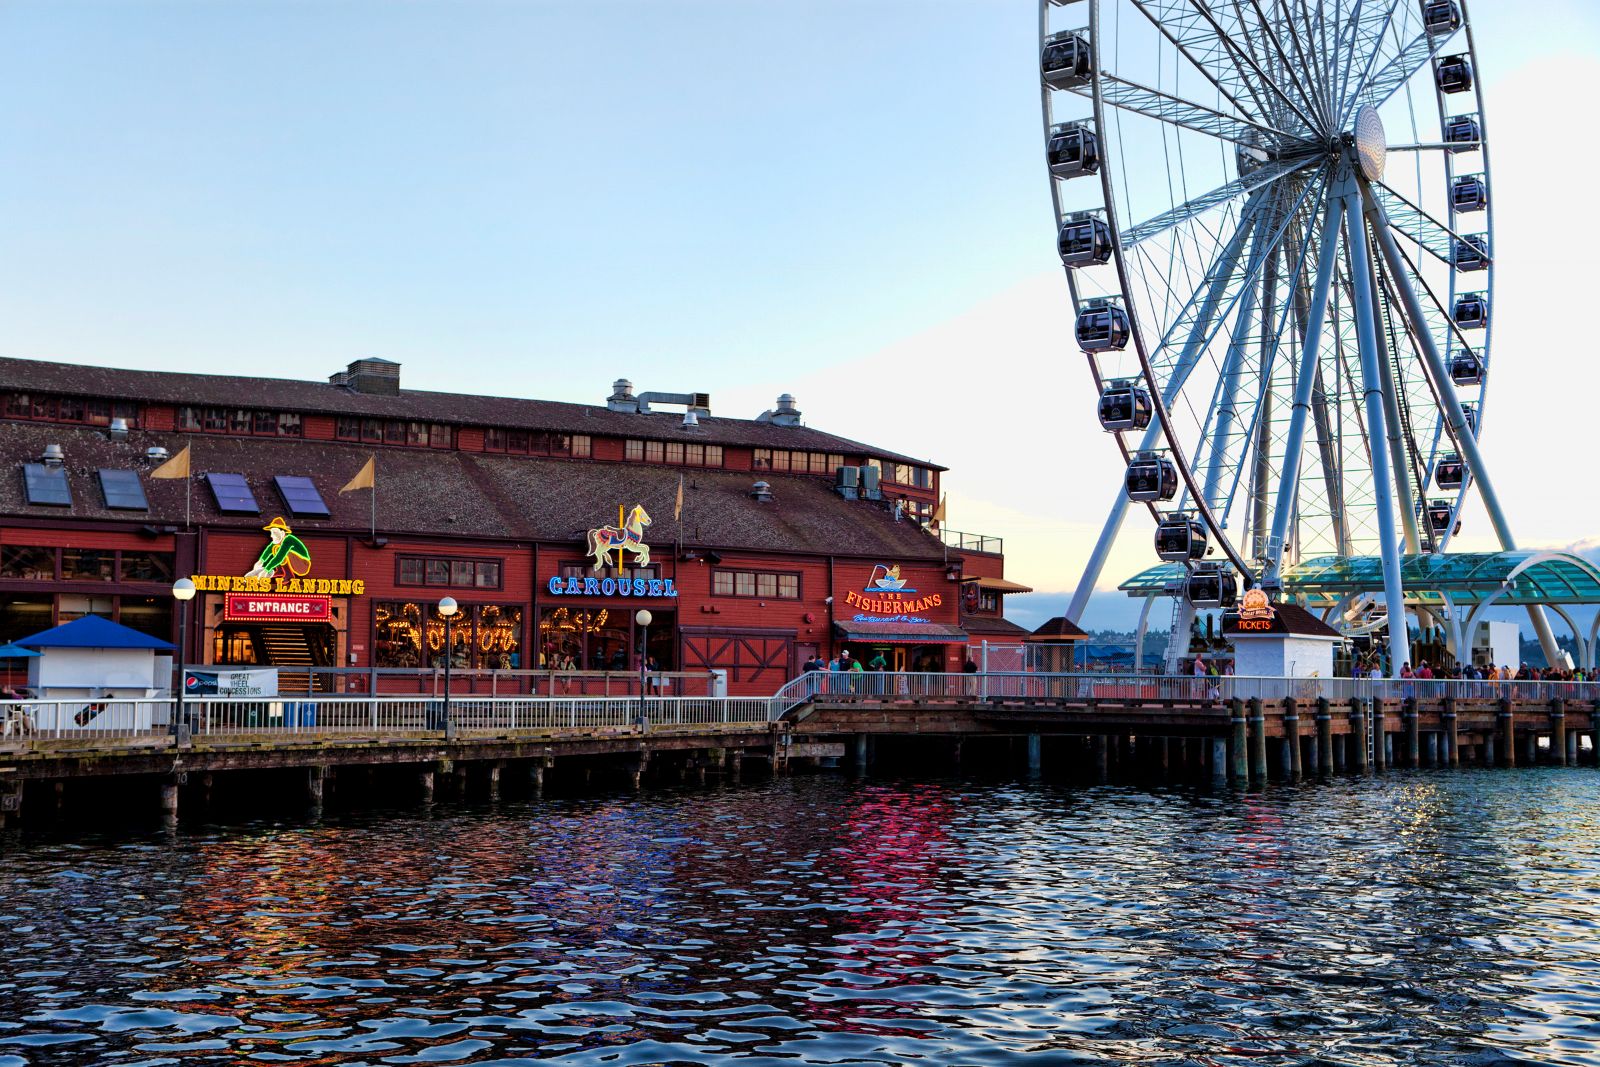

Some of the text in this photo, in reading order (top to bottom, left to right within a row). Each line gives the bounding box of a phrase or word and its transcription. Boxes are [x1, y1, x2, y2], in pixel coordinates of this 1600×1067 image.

[191, 575, 365, 595] MINERS LANDING
[549, 576, 678, 597] CAROUSEL
[248, 601, 310, 613] ENTRANCE
[845, 590, 942, 614] FISHERMANS
[1238, 620, 1271, 630] TICKETS
[198, 679, 218, 687] pepsi
[219, 687, 262, 695] CONCESSIONS
